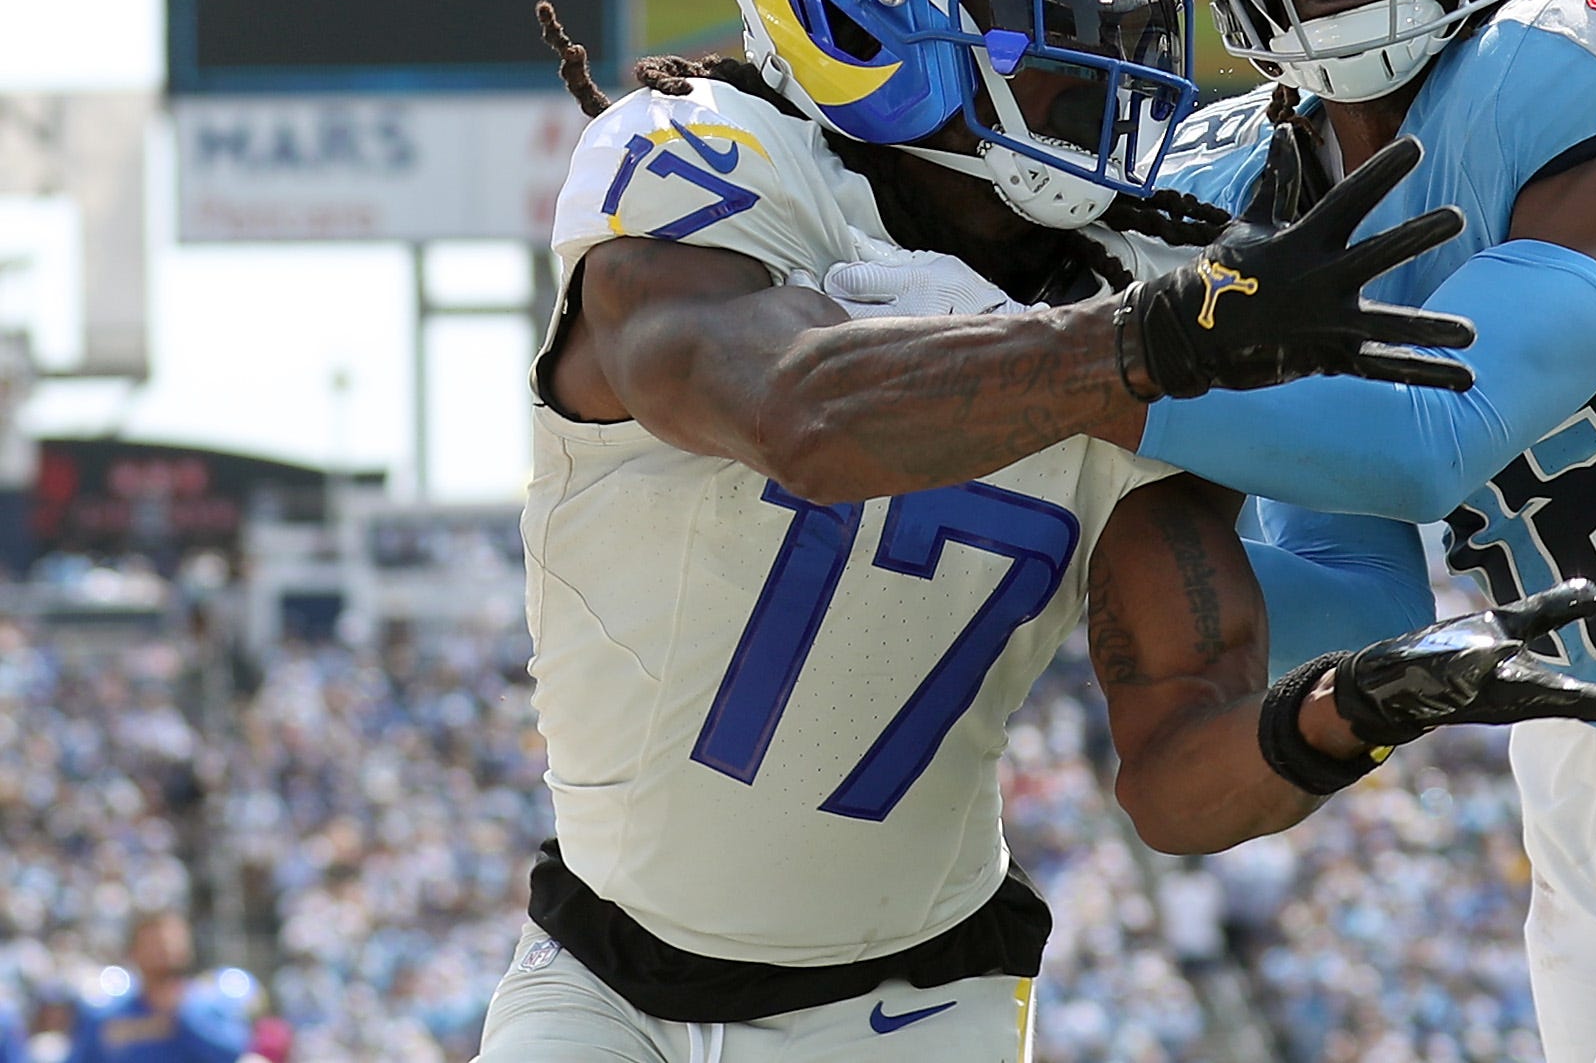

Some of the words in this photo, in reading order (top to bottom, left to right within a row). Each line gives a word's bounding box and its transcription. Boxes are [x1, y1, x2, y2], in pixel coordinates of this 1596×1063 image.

[197, 110, 420, 176] MARS
[600, 132, 760, 241] 17
[690, 479, 1082, 822] 17
